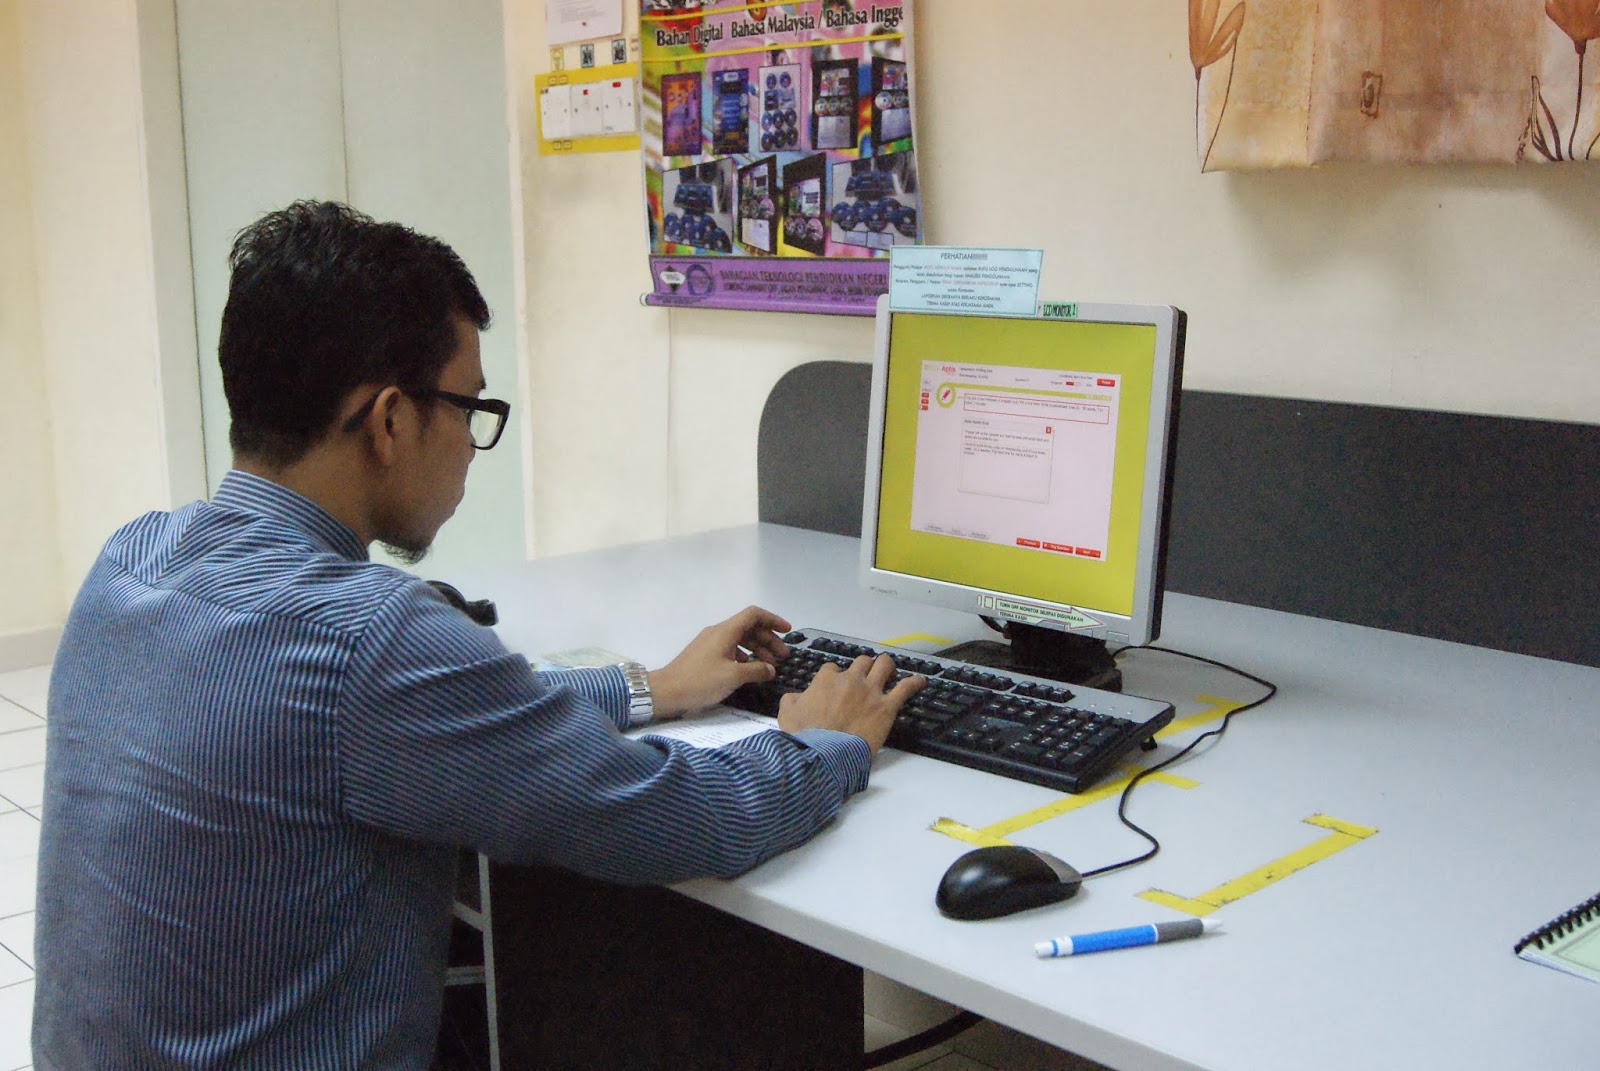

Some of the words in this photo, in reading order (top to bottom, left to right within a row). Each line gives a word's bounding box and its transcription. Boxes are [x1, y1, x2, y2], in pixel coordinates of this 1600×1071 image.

[656, 29, 690, 47] Bahan
[693, 23, 723, 47] Digital
[731, 19, 765, 38] Bahasa
[767, 12, 815, 36] Malaysia
[826, 7, 868, 28] Bahasa
[1019, 605, 1039, 613] MONITOR
